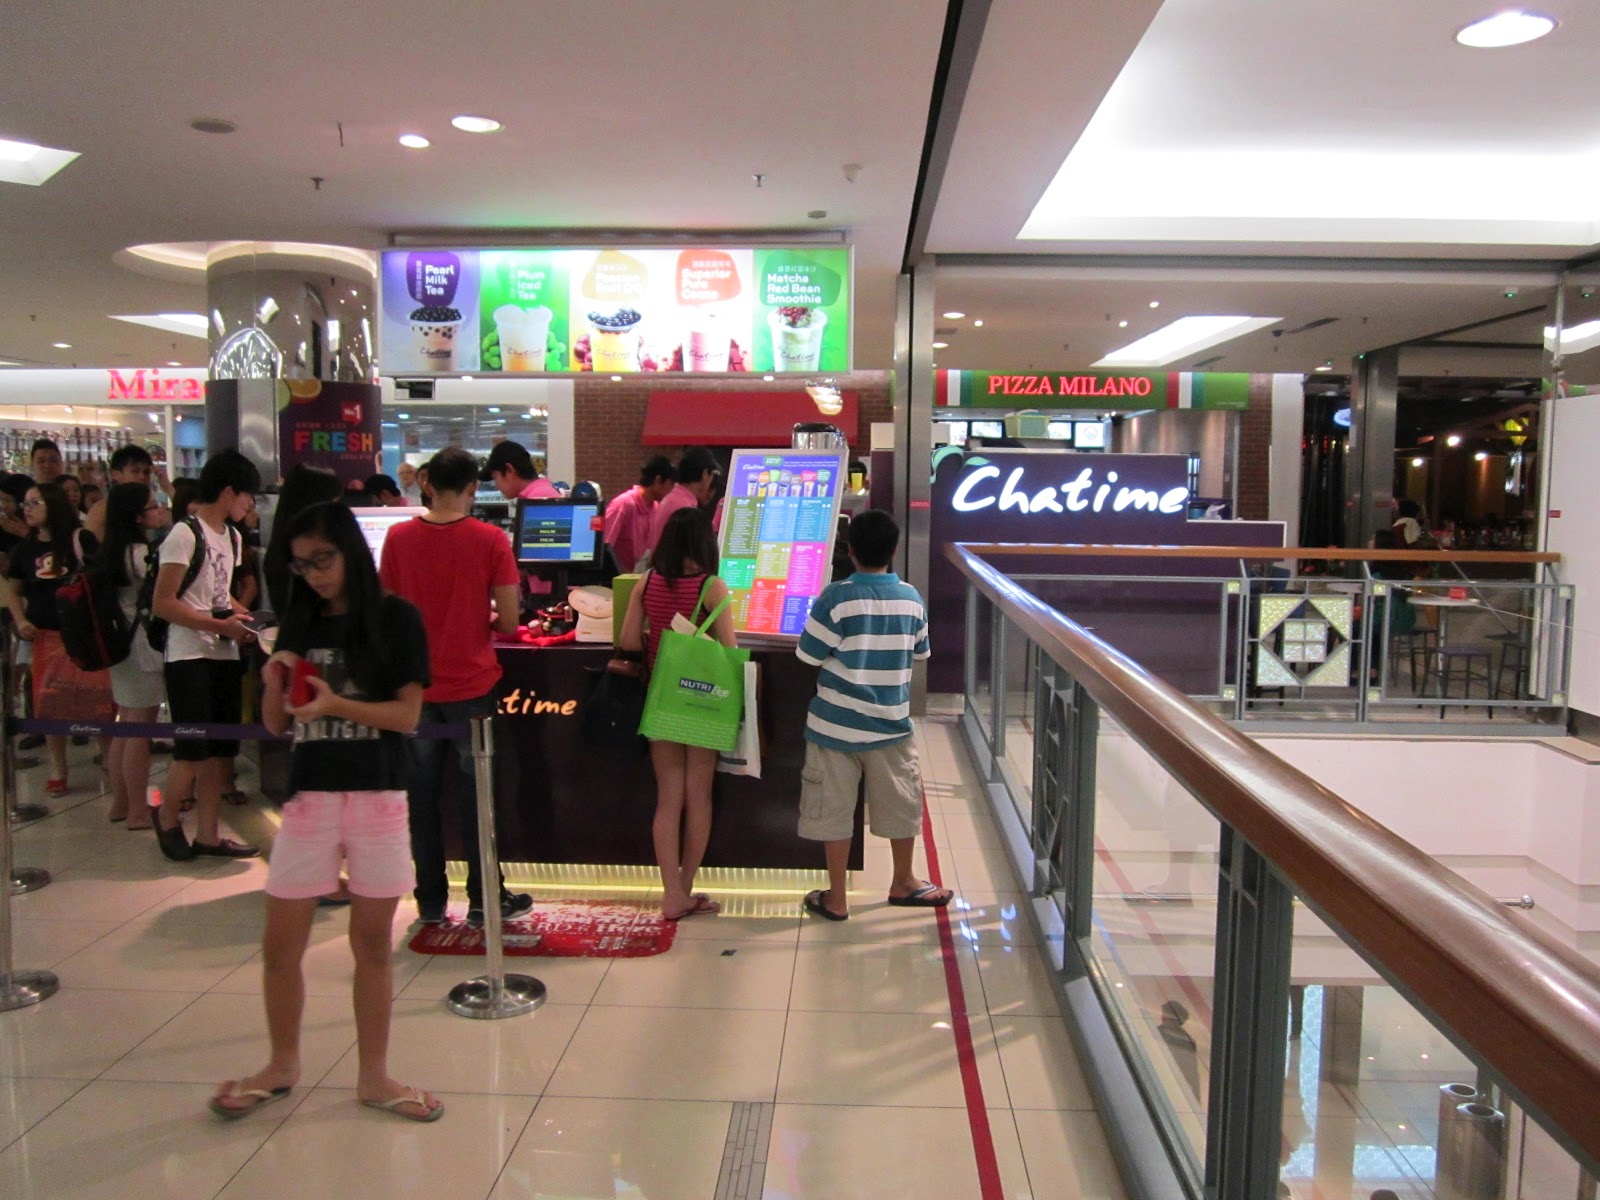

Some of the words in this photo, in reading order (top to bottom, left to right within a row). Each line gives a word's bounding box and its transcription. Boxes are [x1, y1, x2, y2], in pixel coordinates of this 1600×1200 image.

[425, 264, 455, 275] Pearl
[517, 269, 546, 280] Plum
[681, 267, 732, 281] Superior
[425, 275, 448, 285] Milk
[767, 273, 809, 283] Matcha
[517, 280, 542, 290] Iced
[681, 279, 709, 289] Pure
[767, 283, 789, 293] Red
[791, 283, 821, 293] Bean
[425, 285, 445, 295] Tea
[517, 290, 537, 300] Tea
[767, 293, 822, 304] Smoothie
[107, 368, 206, 400] Mira
[988, 375, 1054, 395] PIZZA
[1058, 376, 1152, 396] MILANO
[293, 431, 373, 453] FRESH
[951, 465, 1190, 515] Chatime
[497, 688, 578, 716] time
